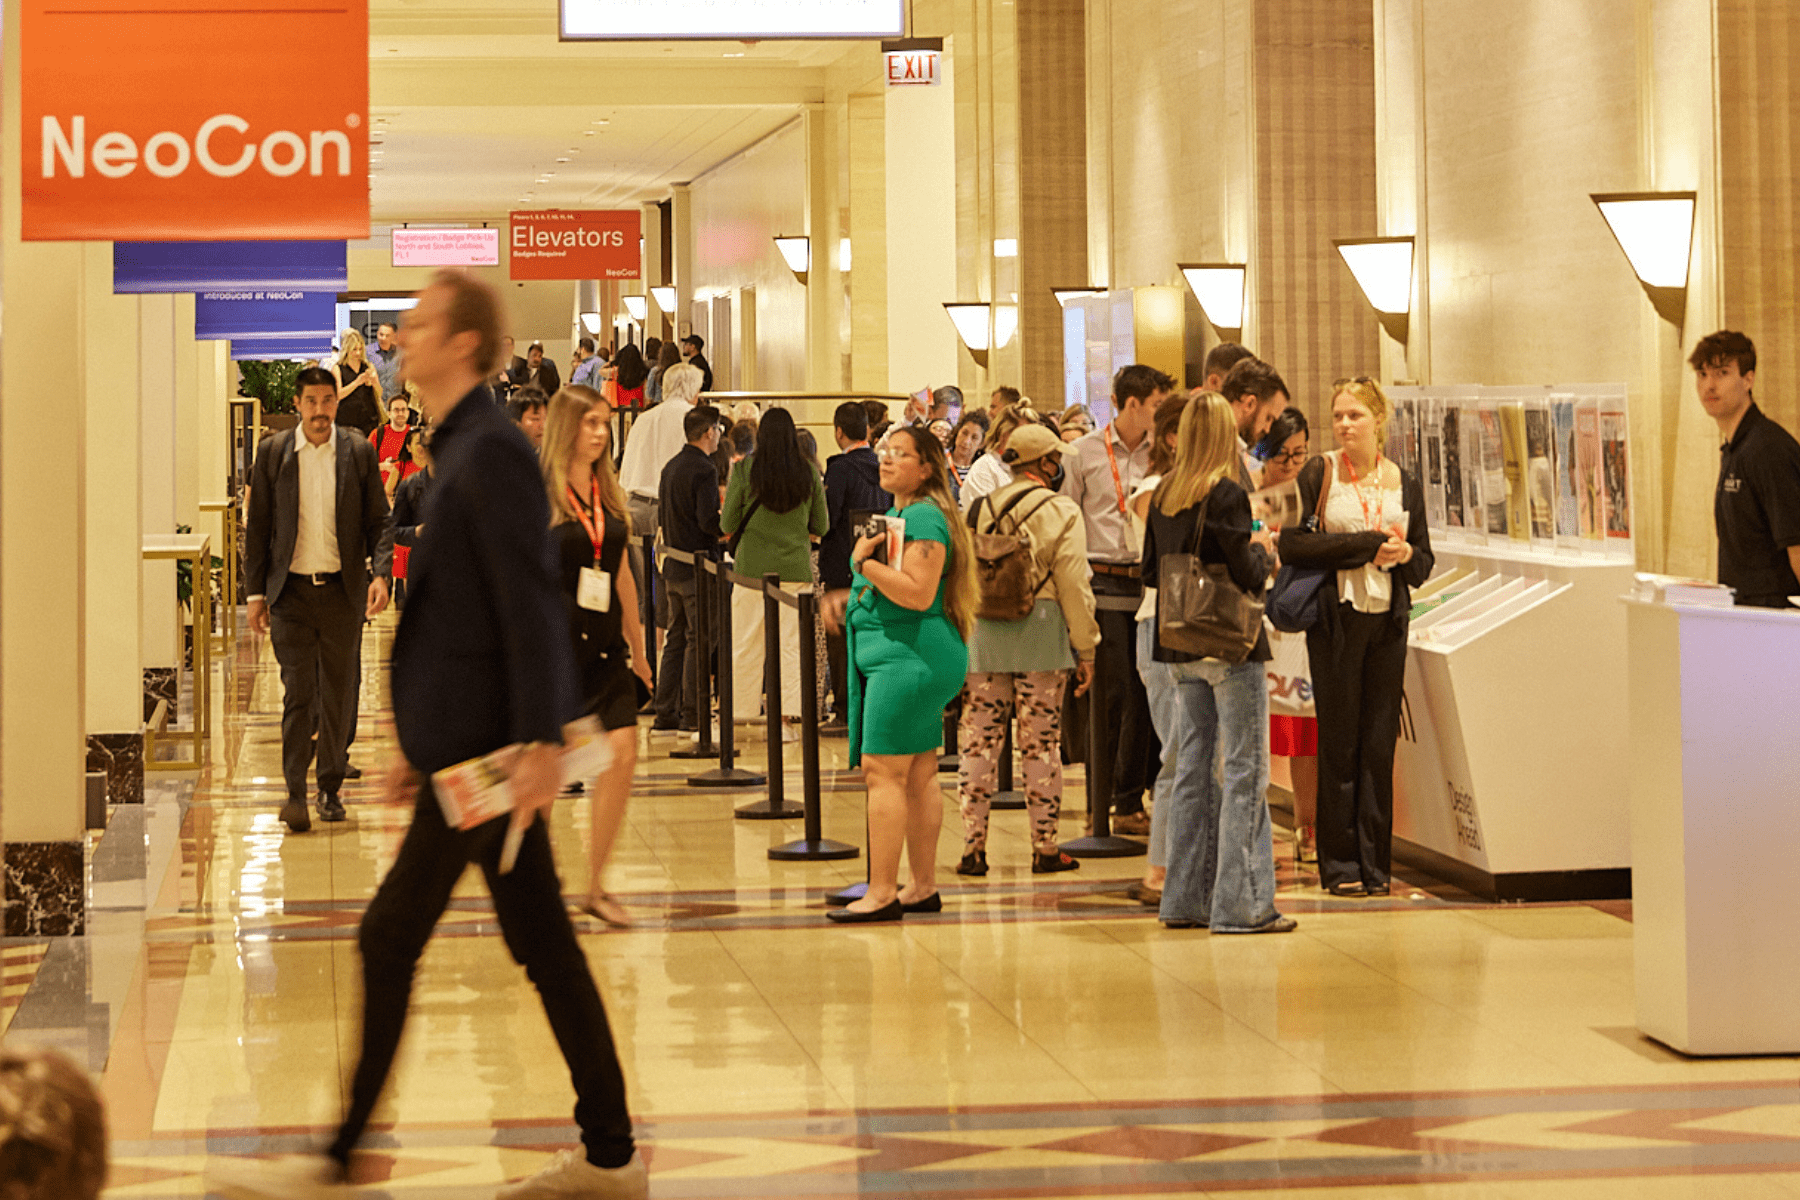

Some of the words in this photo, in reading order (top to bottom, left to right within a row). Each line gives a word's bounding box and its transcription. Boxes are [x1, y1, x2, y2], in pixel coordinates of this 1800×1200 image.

[888, 54, 937, 80] EXIT
[395, 234, 437, 243] Registration
[442, 233, 465, 243] Badge
[512, 225, 624, 247] Elevators
[432, 242, 454, 250] South
[512, 250, 537, 258] Badges
[537, 250, 567, 258] Required
[605, 268, 638, 277] NeoCon
[266, 292, 304, 300] NeoCon
